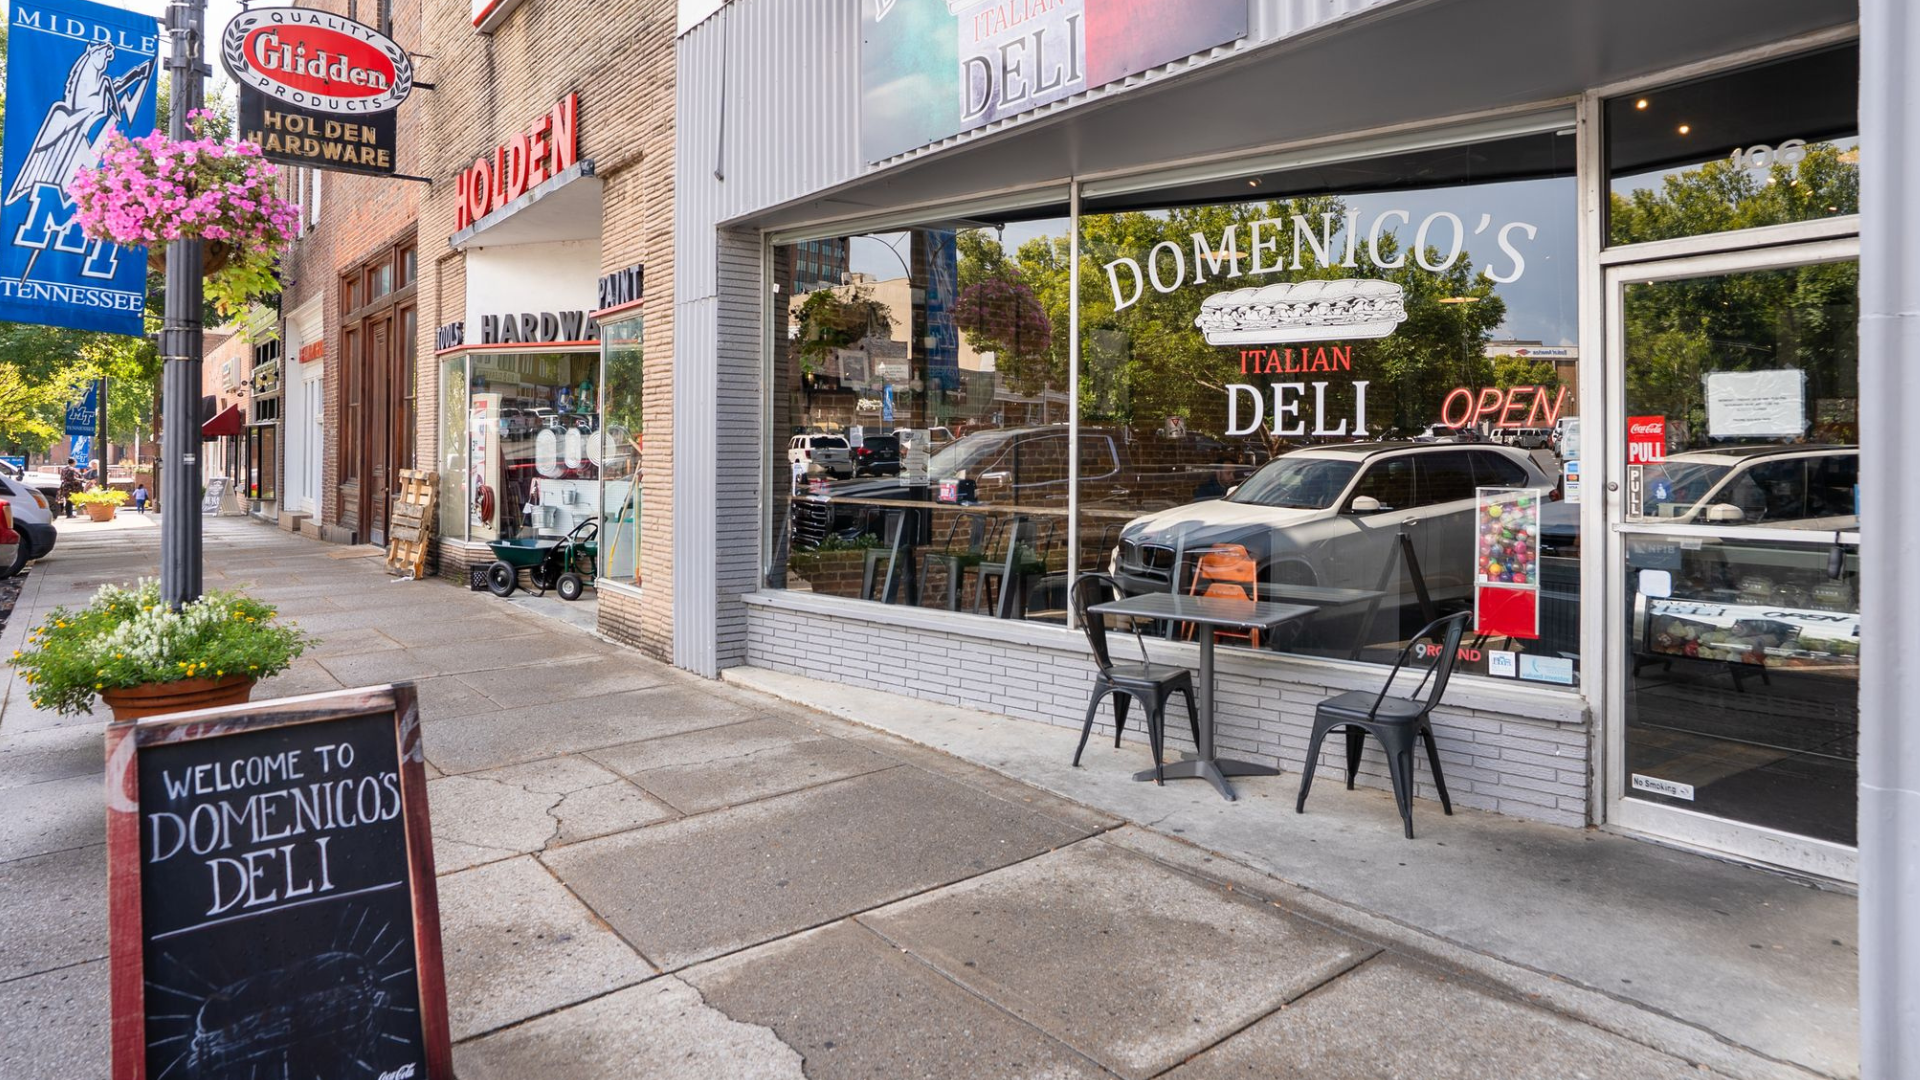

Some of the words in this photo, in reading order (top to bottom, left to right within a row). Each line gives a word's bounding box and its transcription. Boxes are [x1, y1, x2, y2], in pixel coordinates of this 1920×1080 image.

[16, 6, 156, 53] MIDDLE
[270, 11, 377, 42] QUALITY
[253, 30, 392, 90] Glidden
[961, 13, 1084, 121] DELI
[258, 78, 383, 111] PRODUCTS
[263, 110, 377, 146] HOLDEN
[248, 130, 391, 168] HARDWARE
[454, 92, 578, 232] HOLDEN
[1730, 139, 1807, 171] 106
[1103, 209, 1538, 312] DOMENICO'S
[1, 280, 144, 312] TENNESSEE
[598, 264, 644, 309] PAINT
[437, 322, 465, 350] TOOLS
[481, 310, 601, 344] HARDWA
[1240, 345, 1352, 374] ITALIAN
[69, 406, 96, 426] MT
[1225, 380, 1370, 437] DELI
[1441, 385, 1566, 431] OPEN
[1630, 423, 1663, 434] Coca-Cola
[1629, 442, 1665, 462] PULL
[1630, 470, 1640, 515] PULL
[1415, 643, 1482, 662] 9ROND
[163, 749, 304, 801] WELCOME
[314, 742, 355, 773] TO
[1633, 777, 1643, 786] No
[1645, 780, 1677, 795] Smoking
[149, 772, 401, 864] DOMENICO'S
[206, 837, 335, 916] DELI
